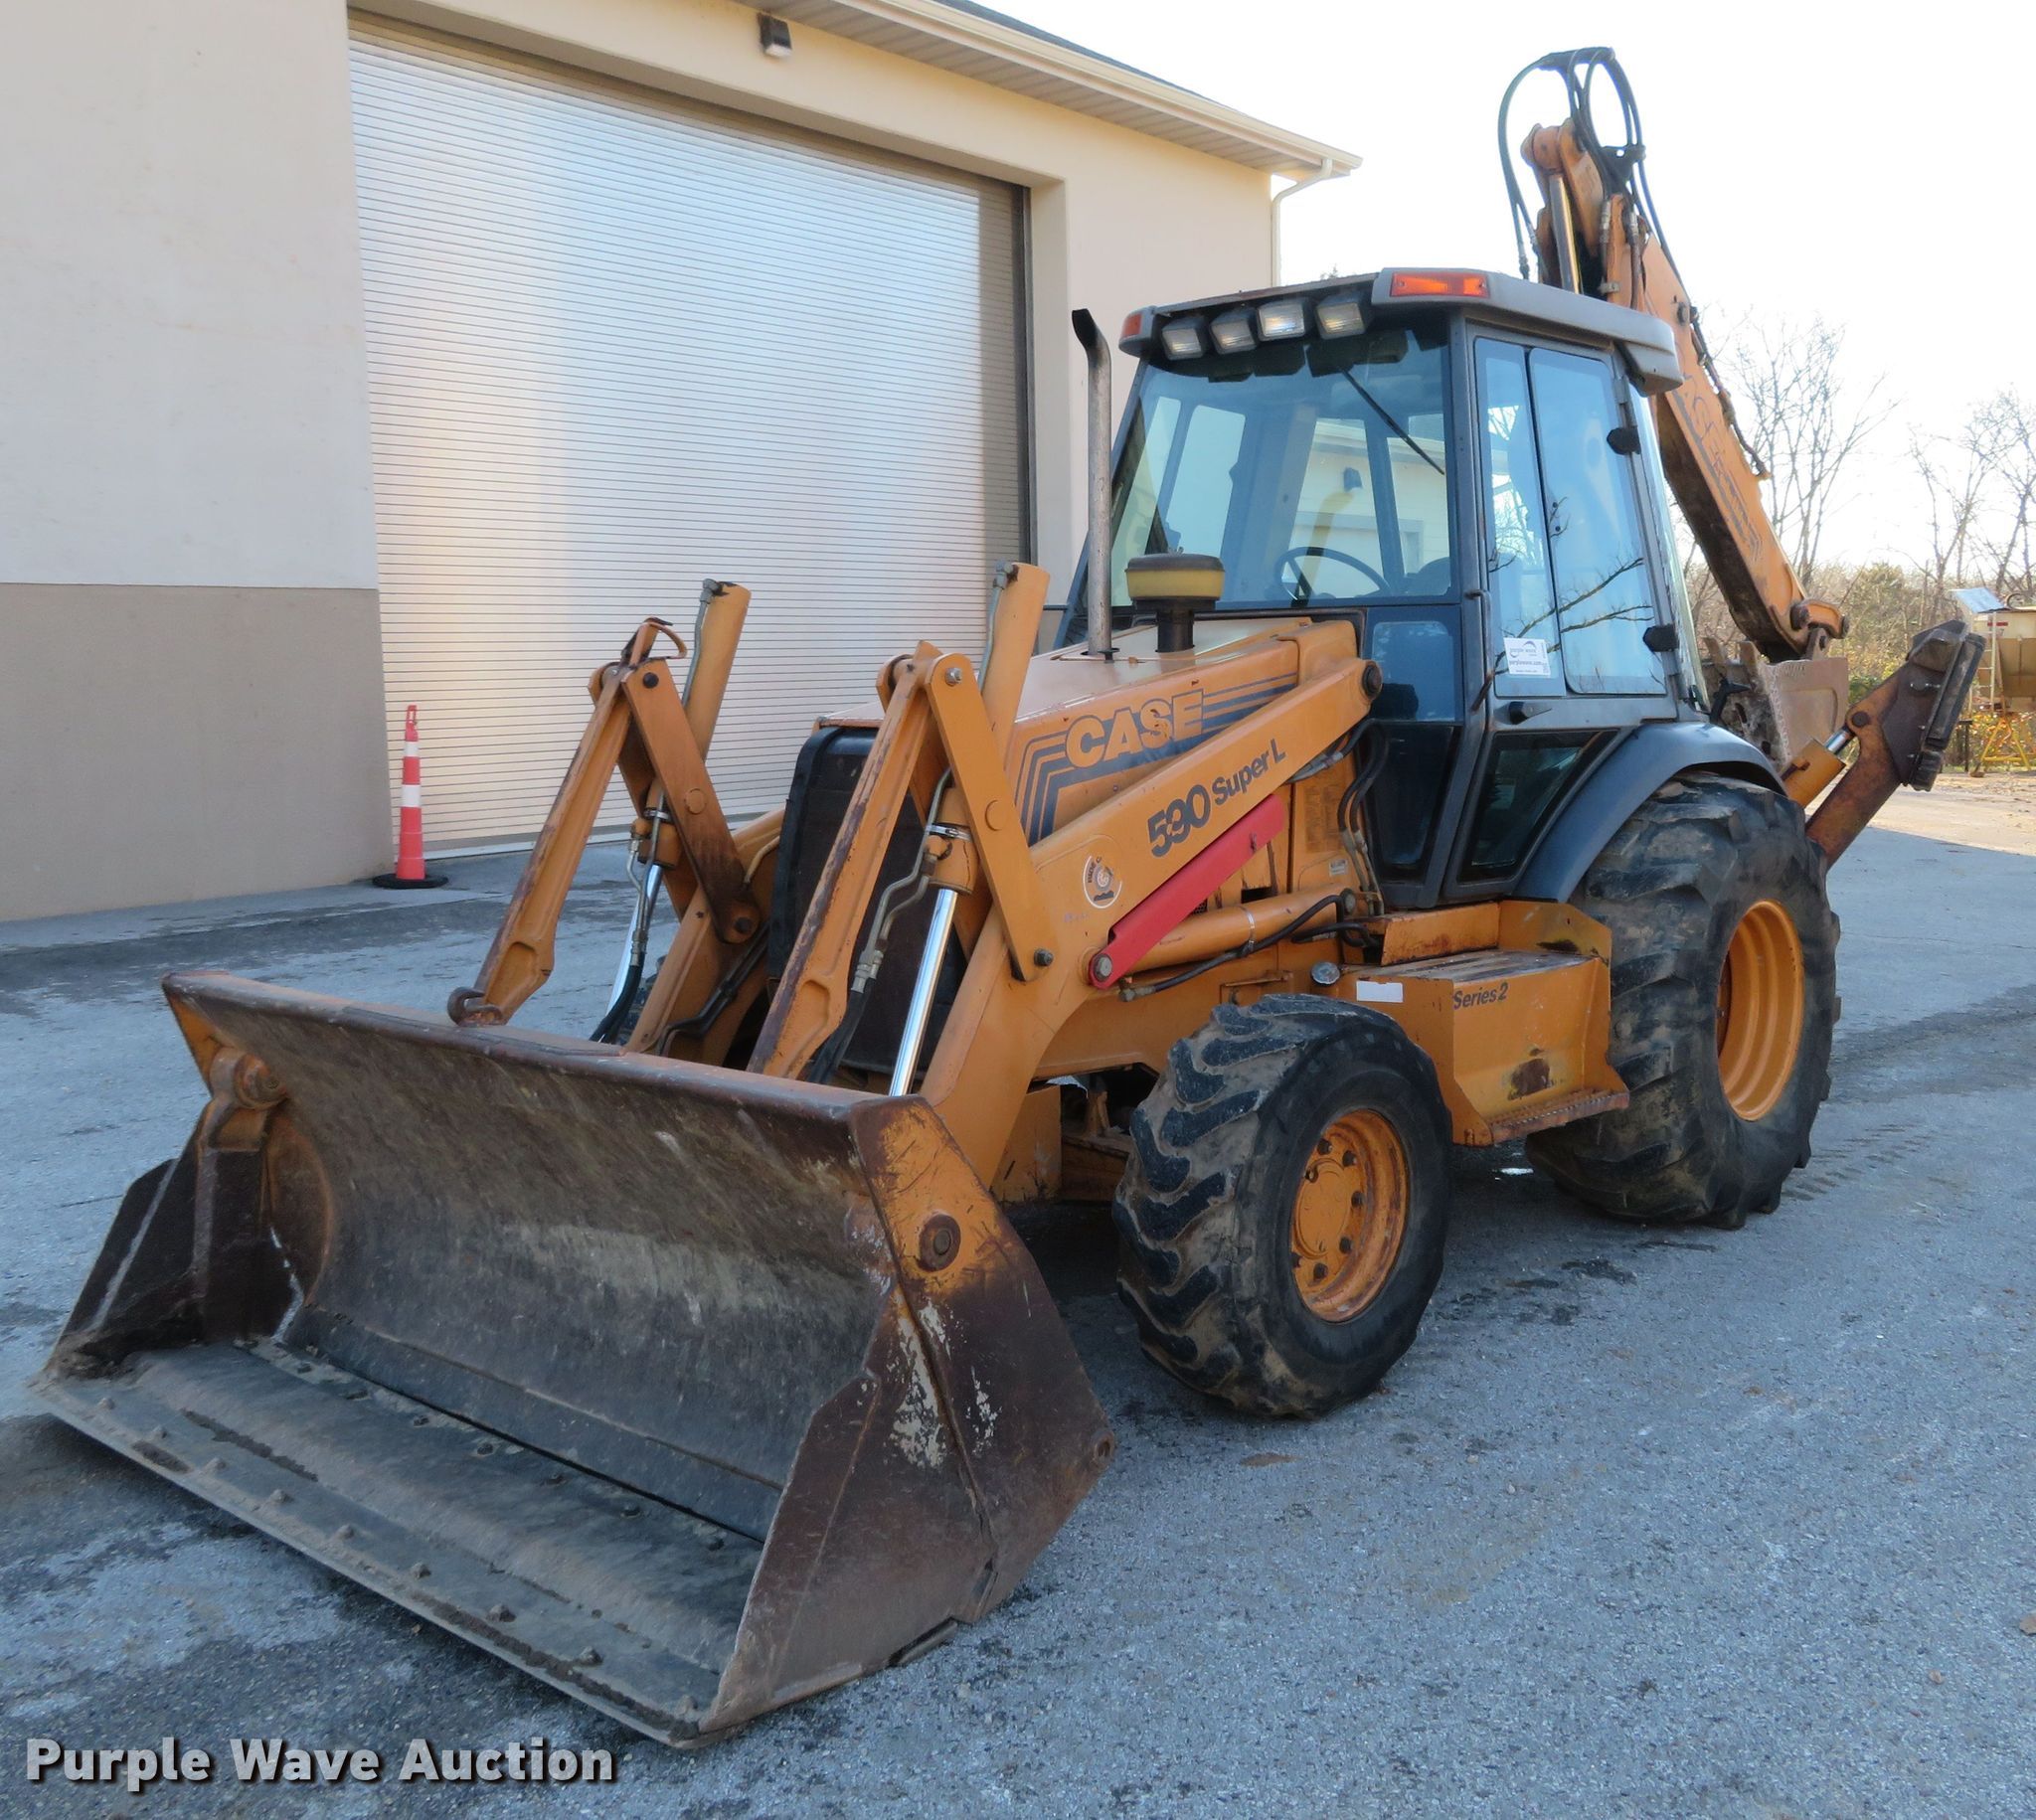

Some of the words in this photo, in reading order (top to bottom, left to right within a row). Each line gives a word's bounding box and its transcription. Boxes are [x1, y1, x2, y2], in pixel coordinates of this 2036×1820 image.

[1065, 688, 1204, 768] CASE
[1147, 784, 1211, 858] 590
[1212, 749, 1270, 806] Super
[1270, 738, 1286, 764] L
[1453, 986, 1497, 1011] Series
[1498, 981, 1509, 1001] 2
